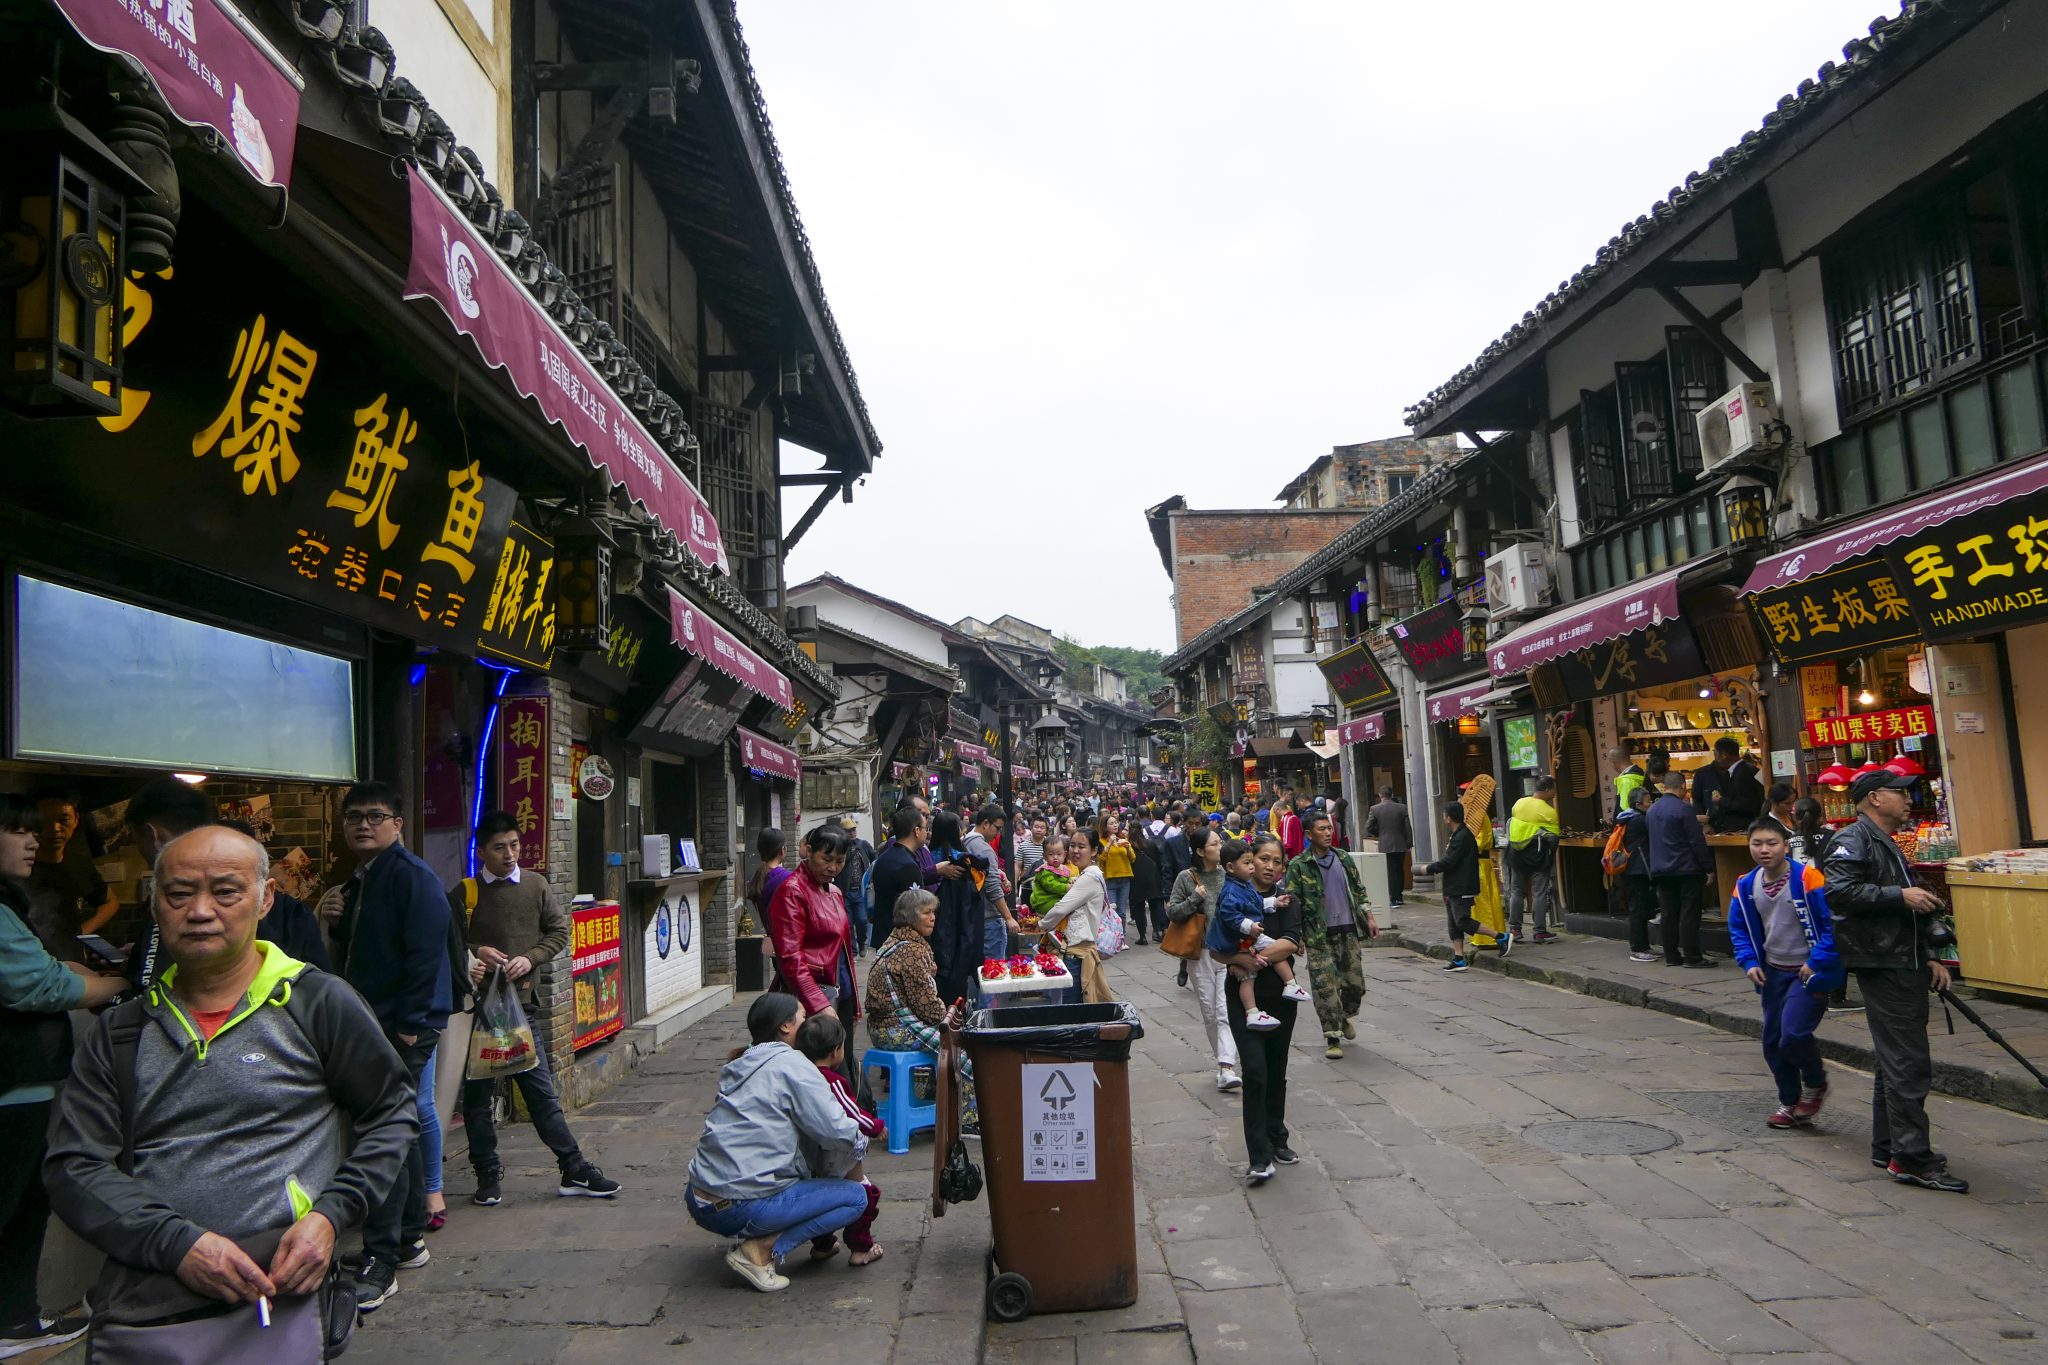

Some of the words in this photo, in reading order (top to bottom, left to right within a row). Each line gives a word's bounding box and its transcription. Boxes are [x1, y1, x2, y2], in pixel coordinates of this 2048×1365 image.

[540, 340, 608, 434] 巩固国家卫生区
[92, 264, 485, 585] 爆鱿鱼
[1762, 576, 1911, 645] 野生板栗
[1929, 587, 2048, 627] HANDMADE
[1814, 709, 1928, 743] 野山栗专卖店
[509, 711, 541, 835] 掏耳朵
[1193, 773, 1217, 807] 張飛
[1042, 1112, 1076, 1121] 其他垃圾
